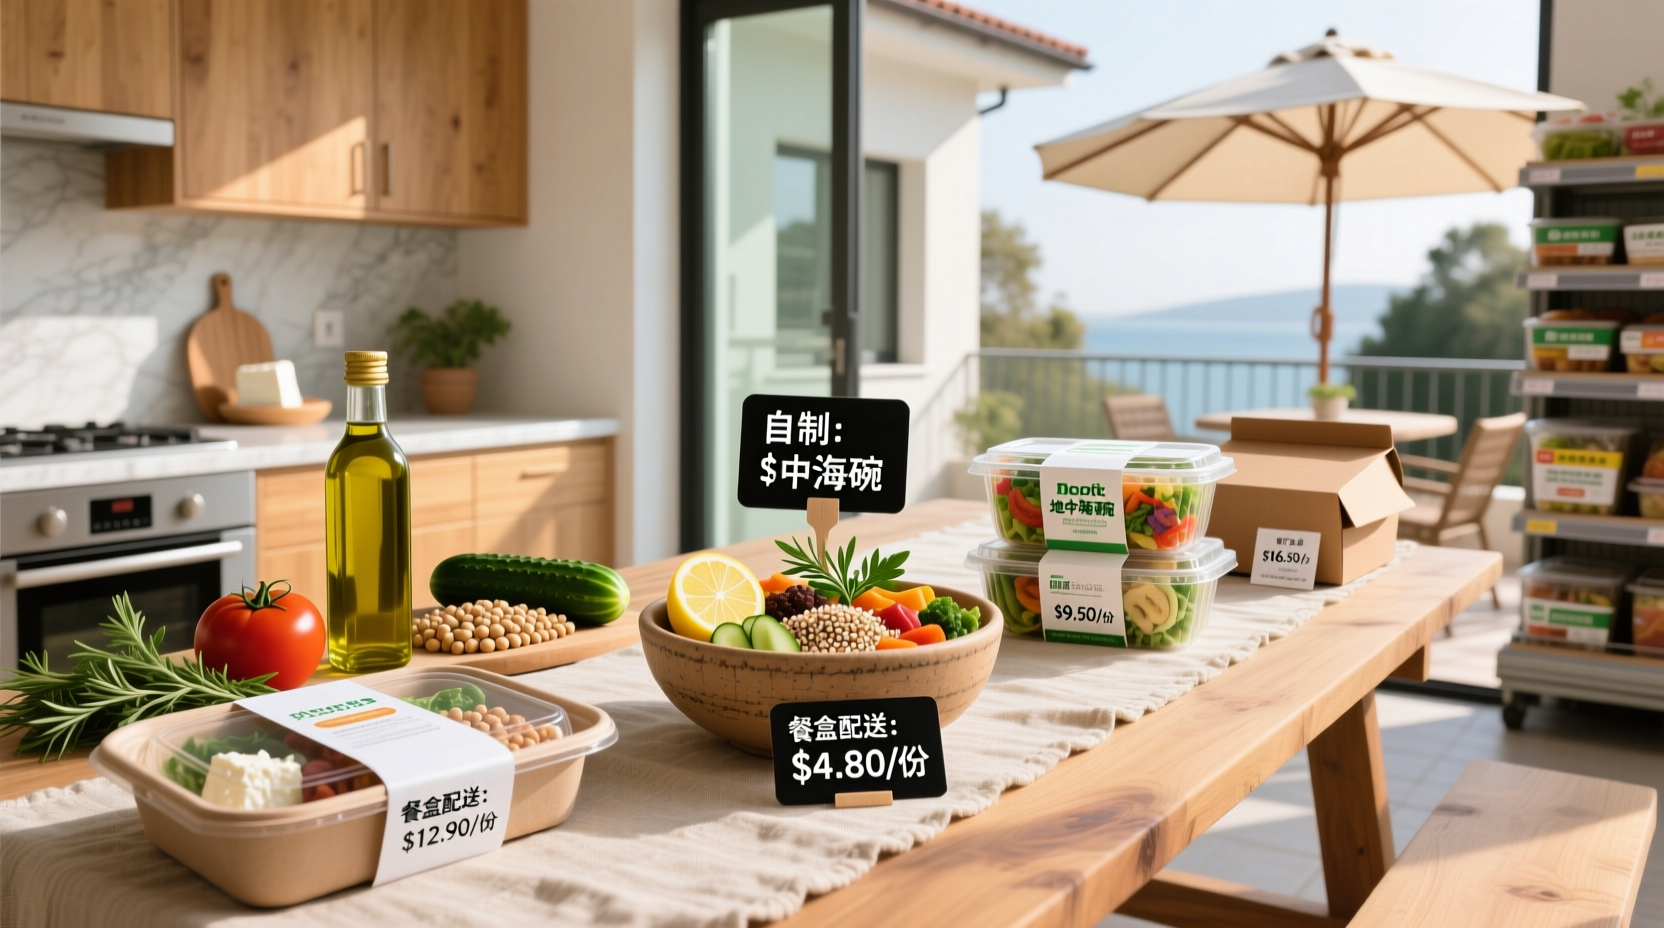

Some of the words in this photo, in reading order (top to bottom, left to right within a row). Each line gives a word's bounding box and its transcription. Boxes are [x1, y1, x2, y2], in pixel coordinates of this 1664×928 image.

[766, 410, 842, 446] 自制:
[760, 452, 883, 491] $中海碗
[788, 712, 898, 743] 餐盒配送:
[791, 745, 930, 785] $4.80/份
[401, 786, 488, 823] 餐盒配送:
[402, 811, 498, 854] $12.90/份
